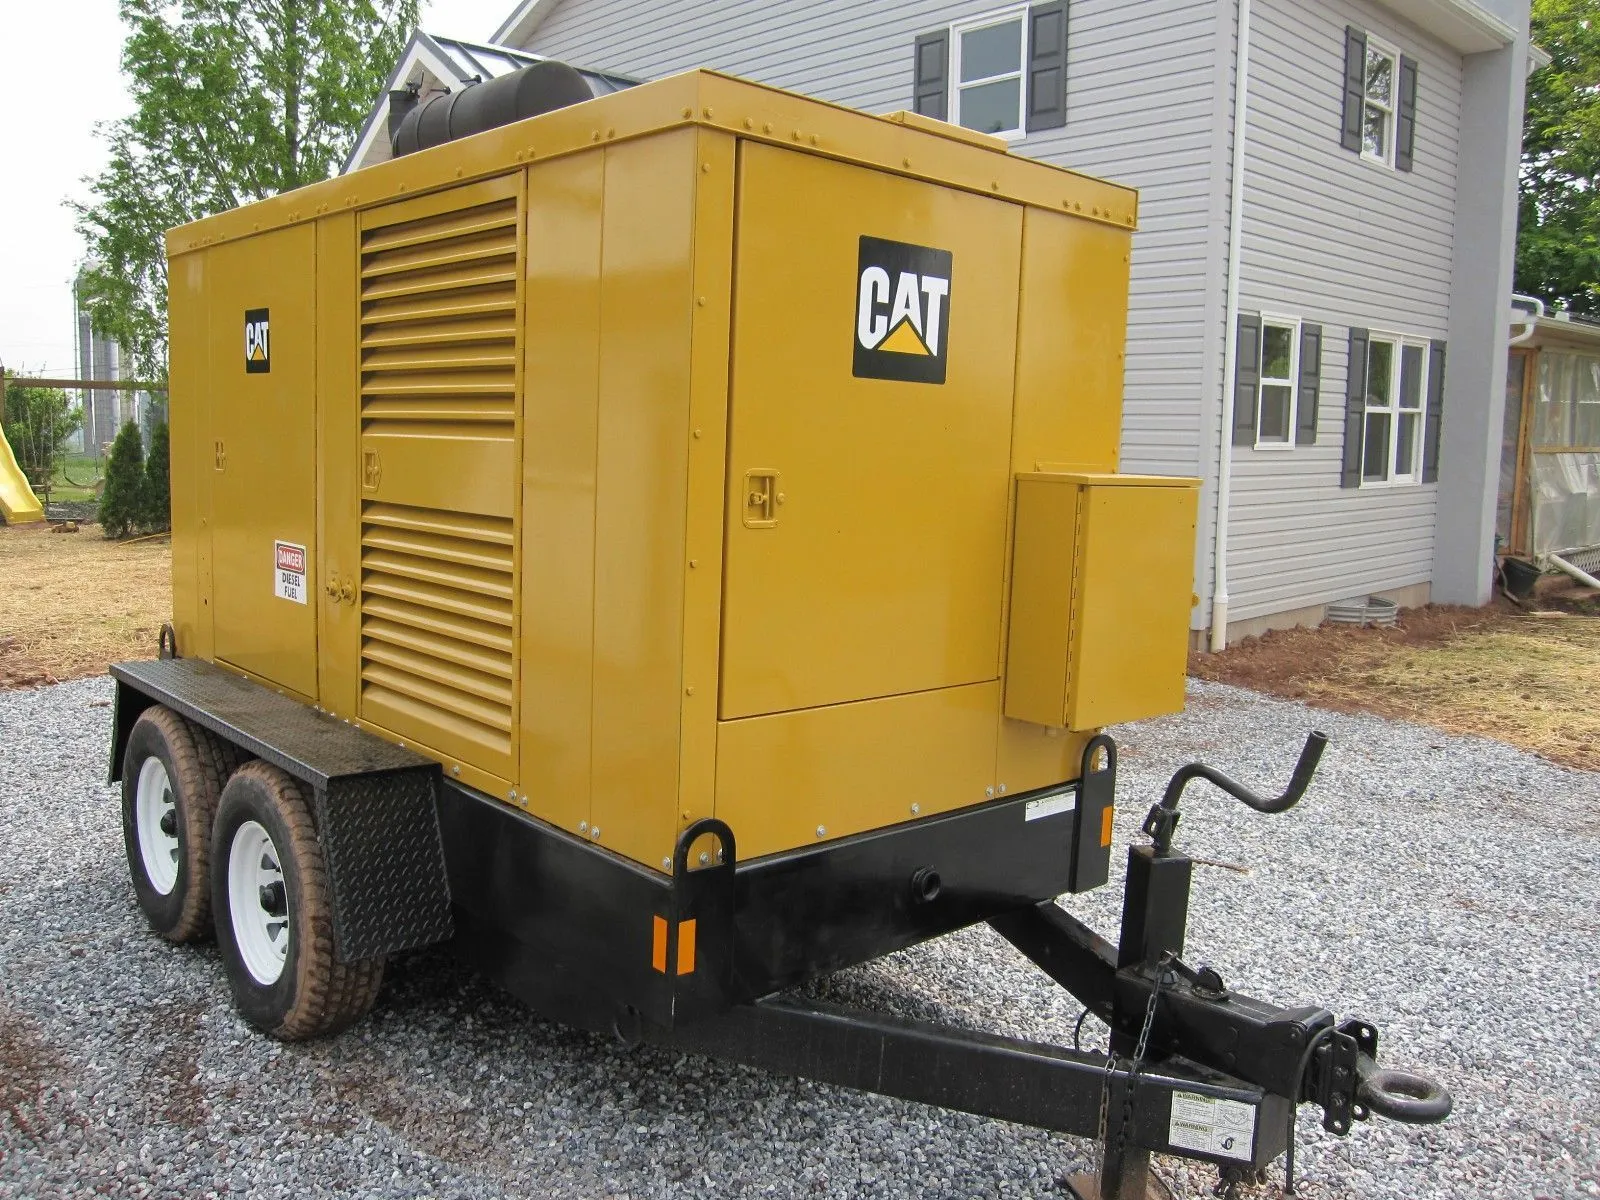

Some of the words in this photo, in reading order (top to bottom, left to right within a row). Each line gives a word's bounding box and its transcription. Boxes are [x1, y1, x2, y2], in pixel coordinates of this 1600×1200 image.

[858, 266, 948, 357] CAT
[246, 321, 269, 361] CAT
[279, 550, 303, 569] DANGER
[282, 572, 300, 587] DIESEL
[285, 586, 297, 600] FUEL
[1182, 1093, 1211, 1104] WARNING
[1180, 1121, 1208, 1132] WARNING
